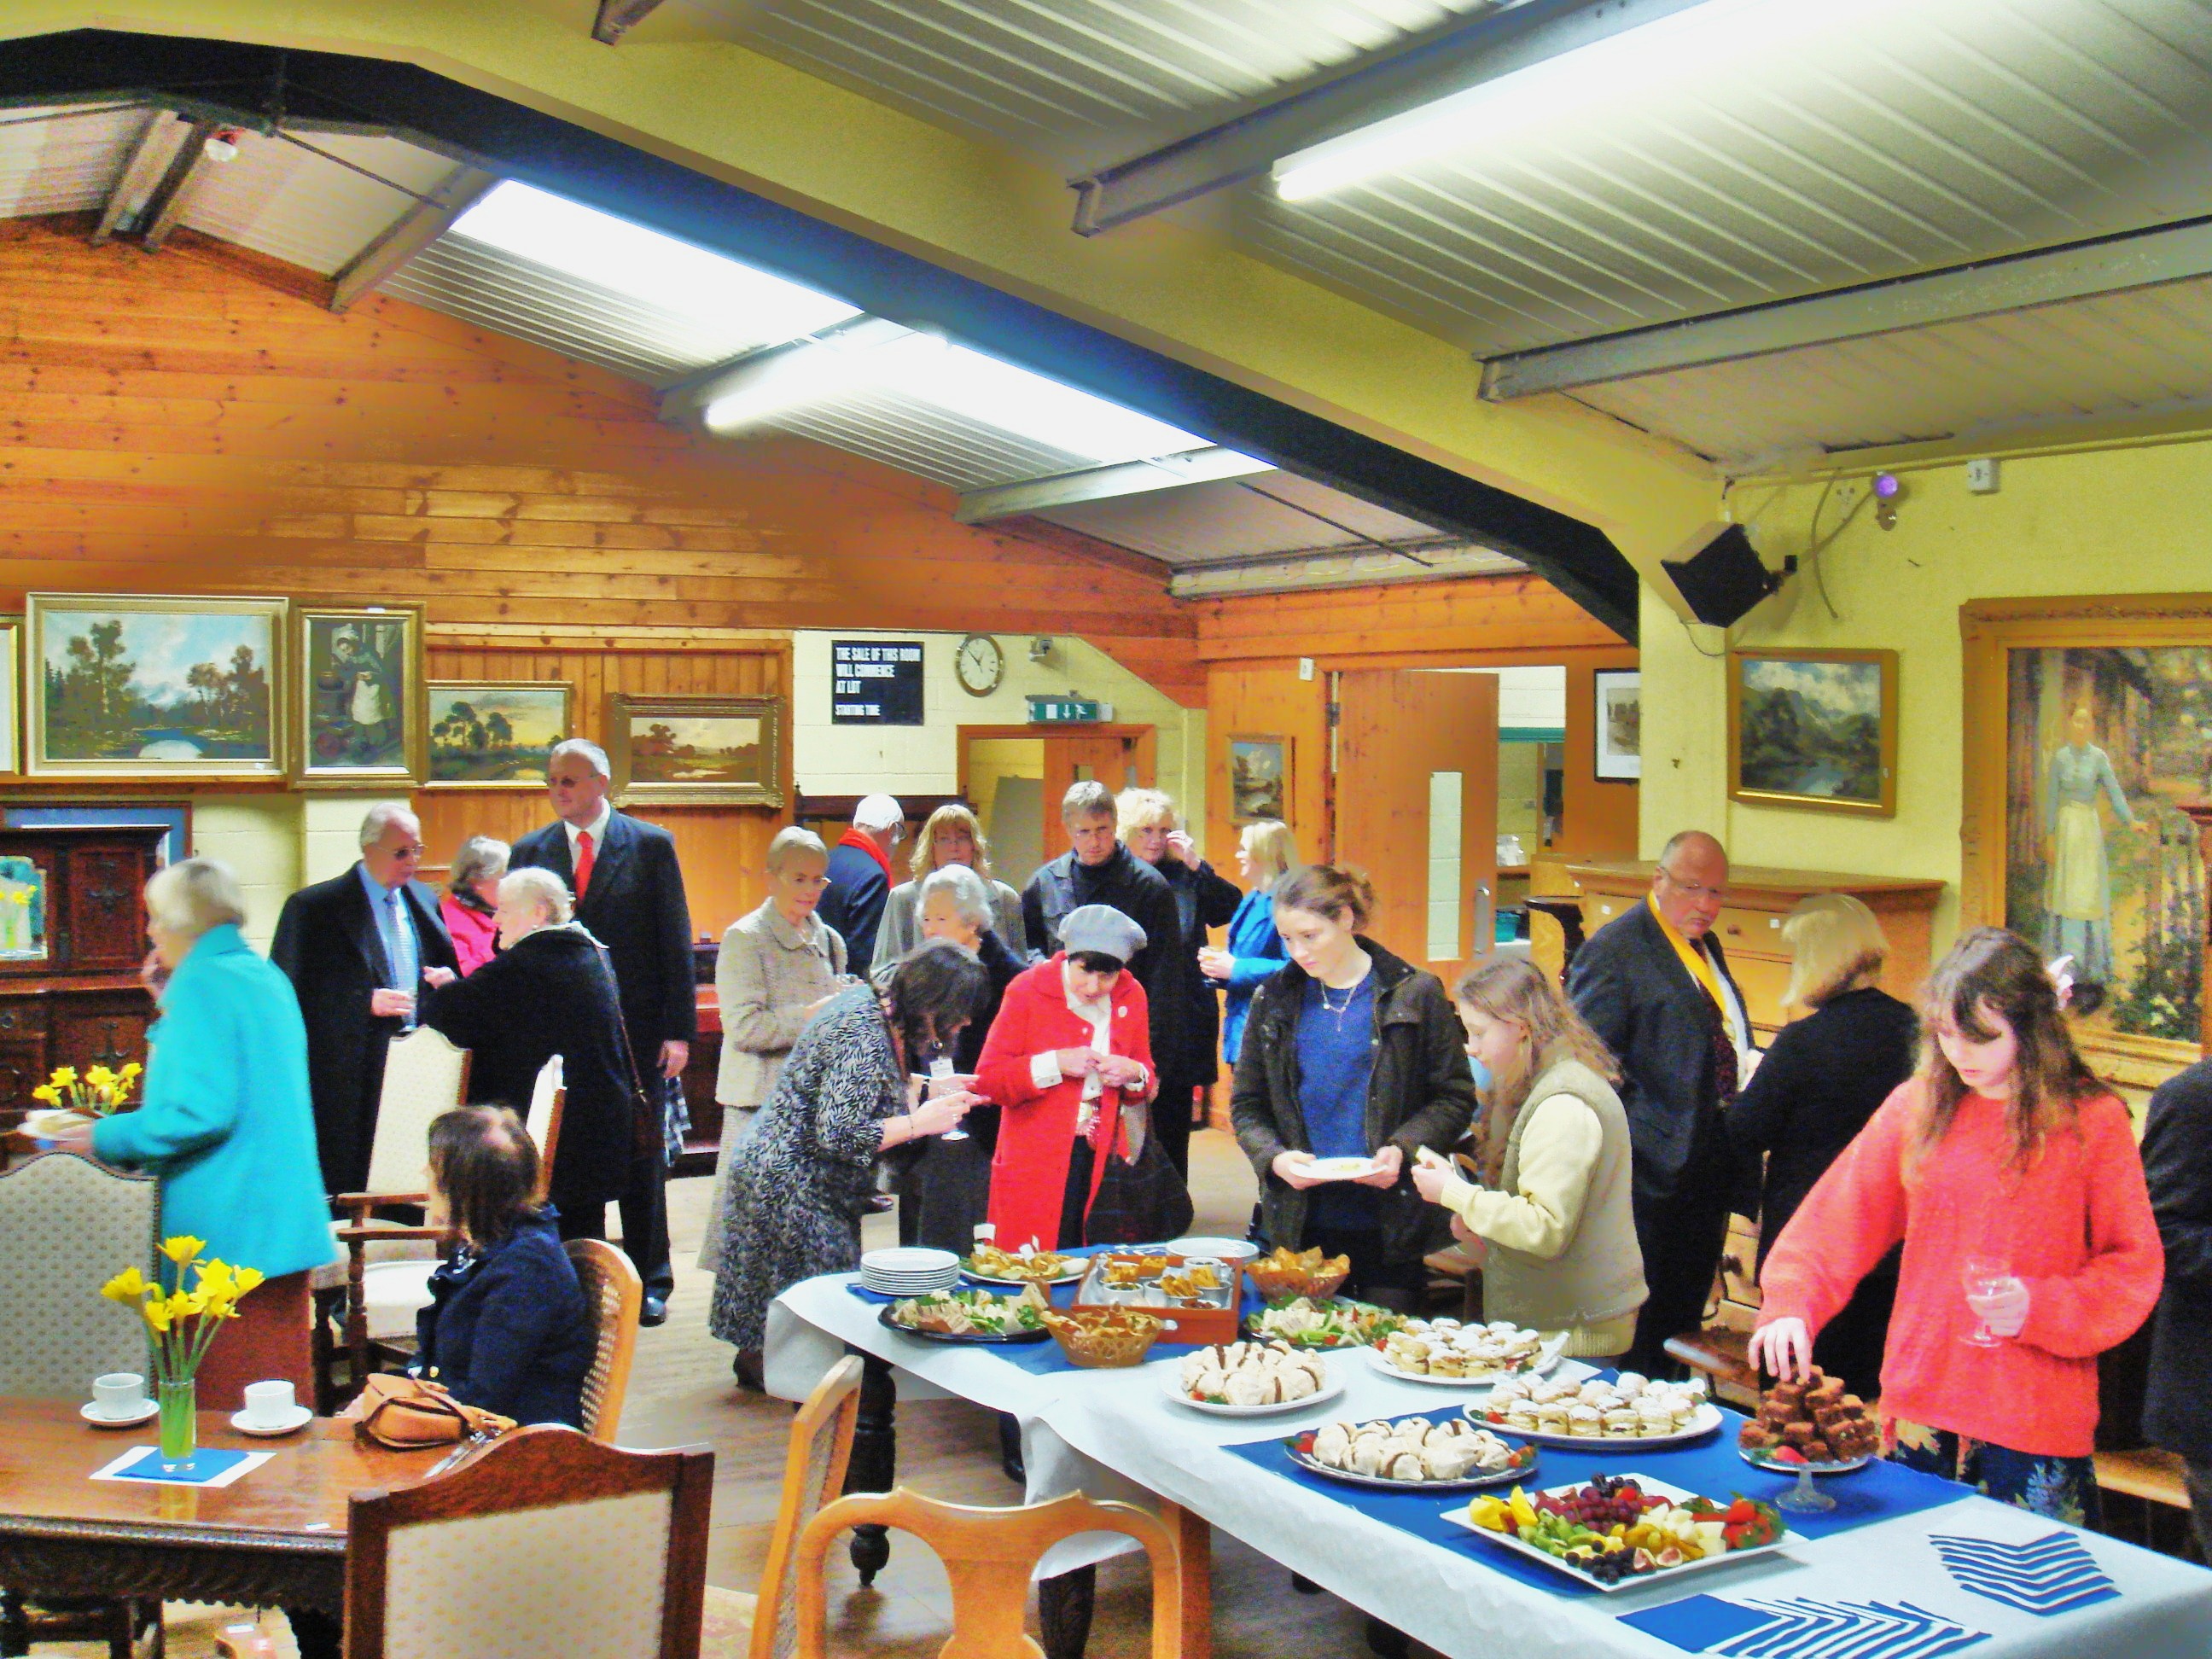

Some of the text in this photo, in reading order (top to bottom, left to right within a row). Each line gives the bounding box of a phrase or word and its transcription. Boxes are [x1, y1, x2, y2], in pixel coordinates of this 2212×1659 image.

[835, 647, 851, 661] THE
[852, 647, 870, 661] SALE
[882, 648, 899, 661] THIS
[835, 663, 854, 678] WILL
[847, 680, 861, 694] LOT
